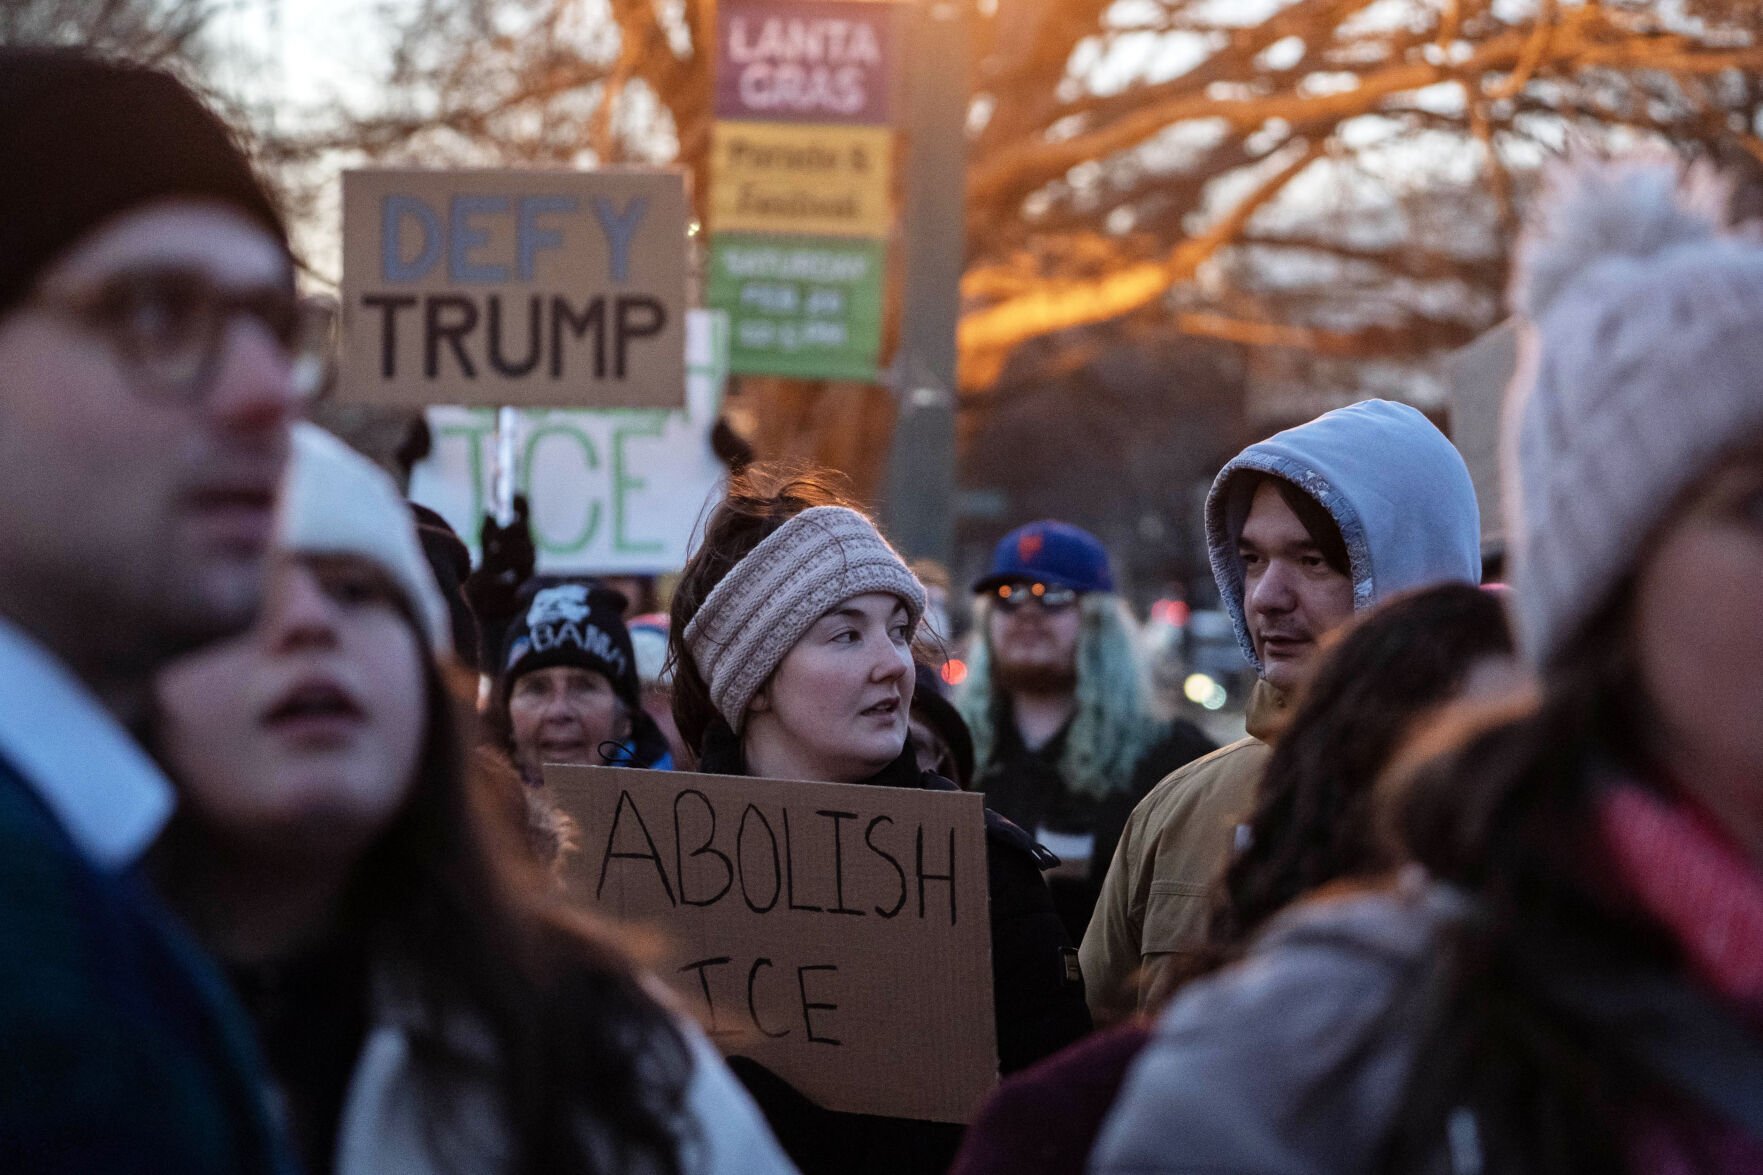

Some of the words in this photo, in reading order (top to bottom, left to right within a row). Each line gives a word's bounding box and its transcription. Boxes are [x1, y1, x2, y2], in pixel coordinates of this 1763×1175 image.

[728, 15, 882, 66] LANTA
[738, 62, 867, 114] GRAS
[381, 193, 650, 285] DEFY
[361, 292, 669, 381] TRUMP
[440, 423, 667, 556] ICE
[596, 788, 957, 926] ABOLISH
[676, 956, 843, 1046] ICE
